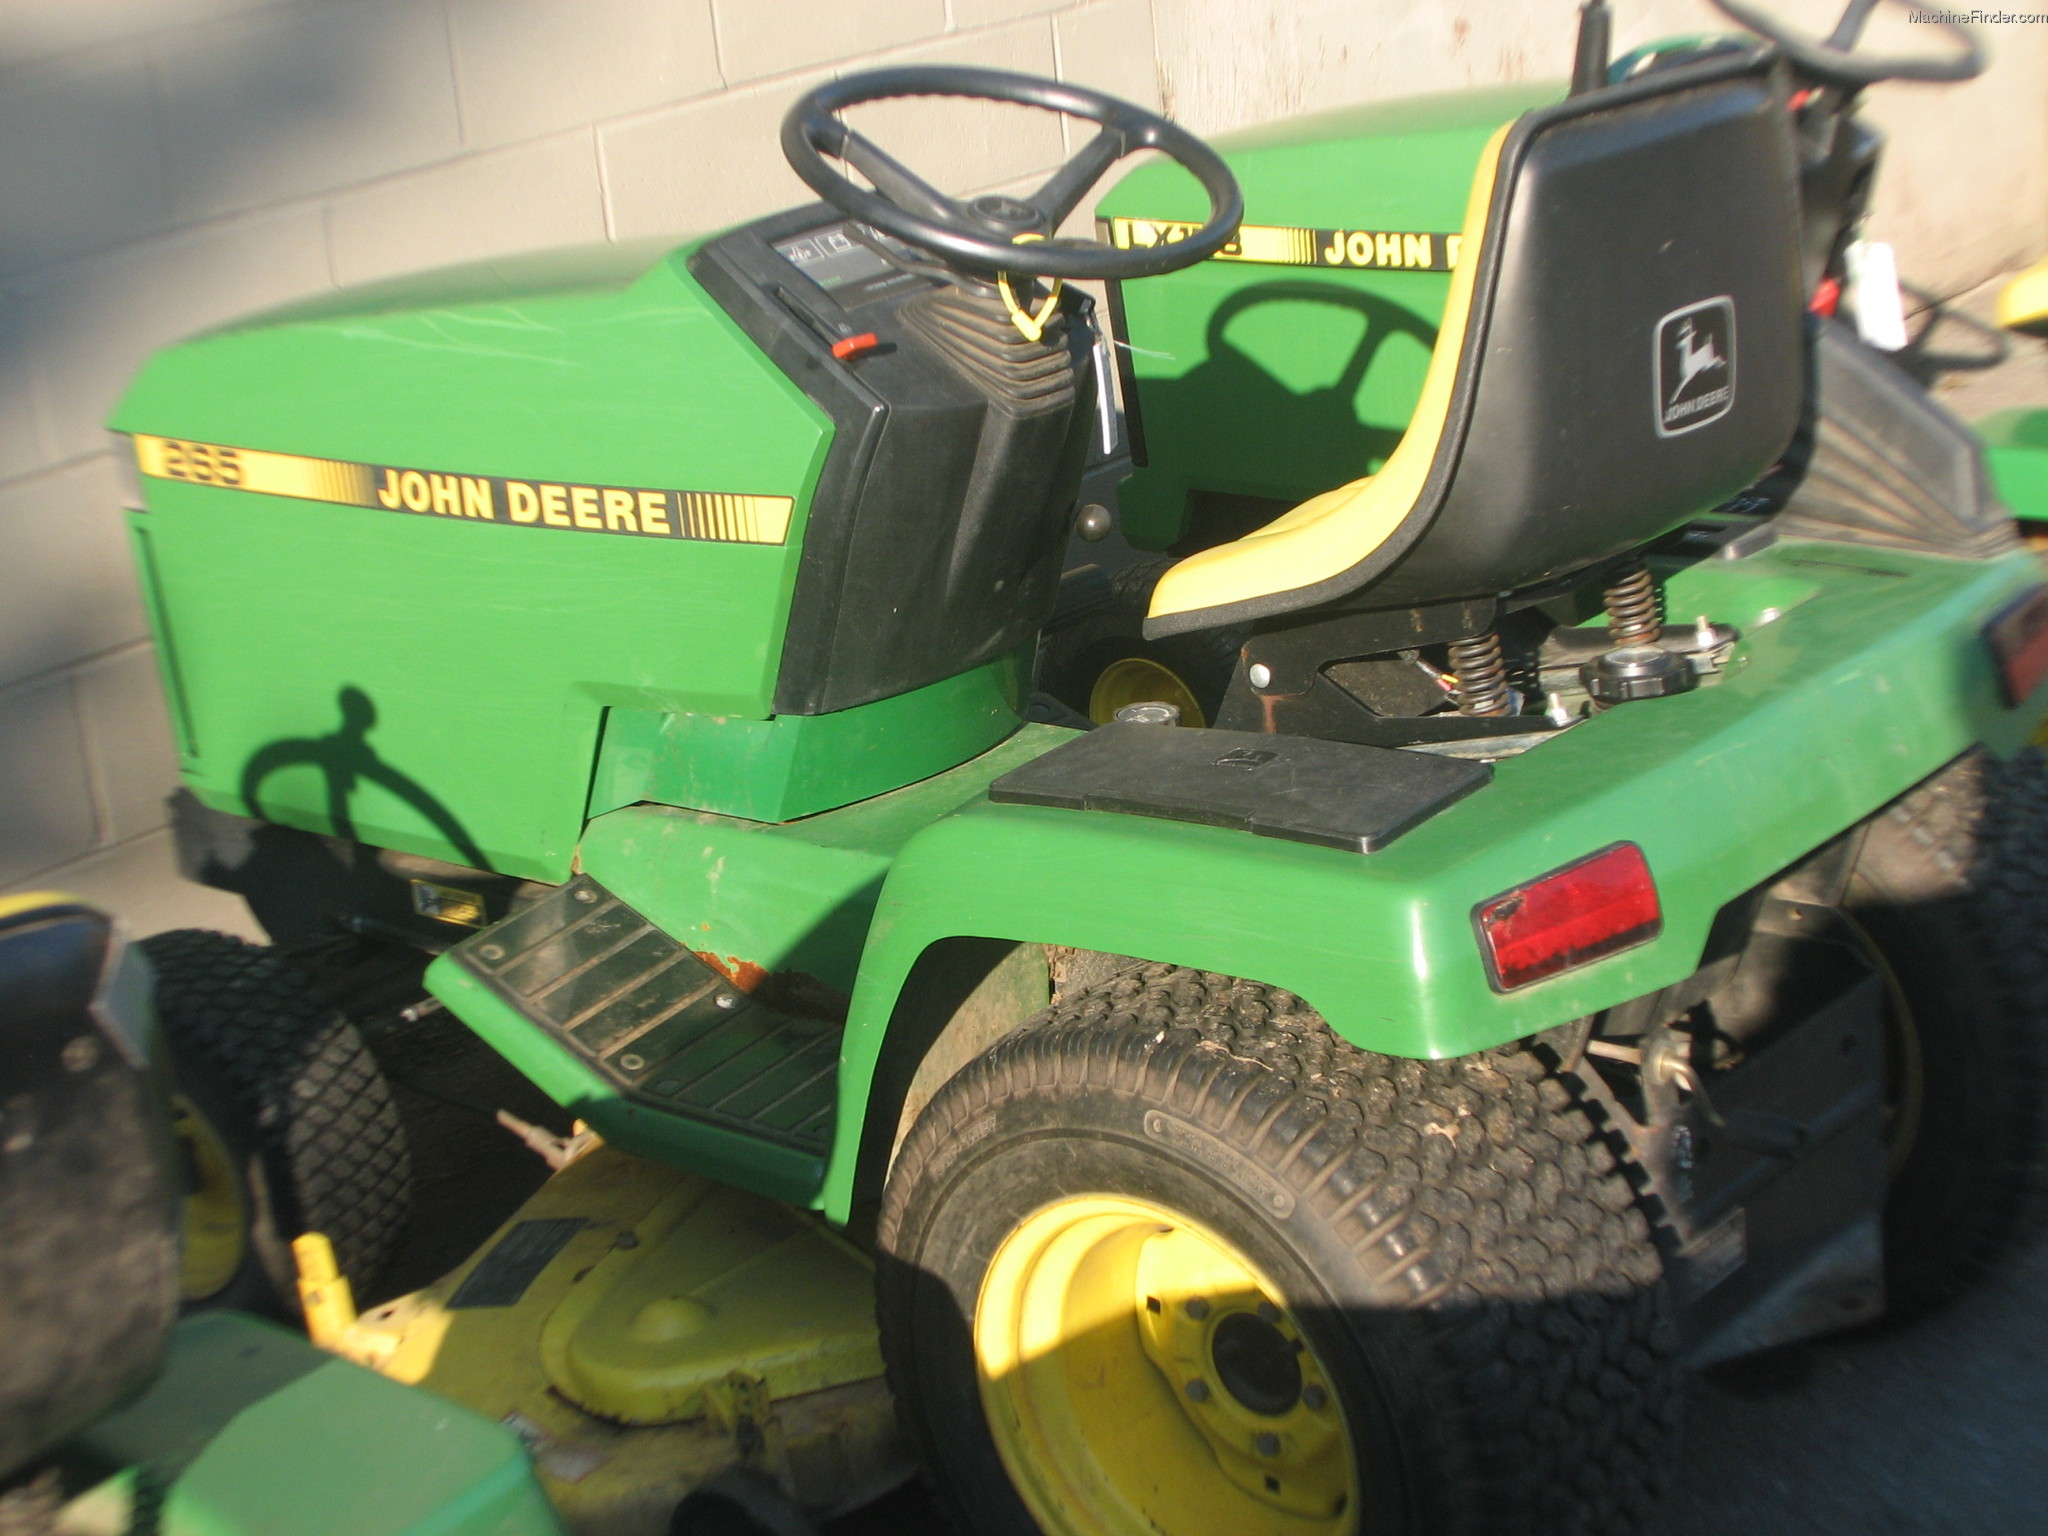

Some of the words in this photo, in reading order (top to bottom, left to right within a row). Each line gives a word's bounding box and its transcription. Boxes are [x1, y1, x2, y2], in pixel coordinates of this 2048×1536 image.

[1324, 230, 1432, 268] JOHN
[1665, 397, 1695, 422] JOHN
[1695, 385, 1730, 411] DEERE
[378, 468, 495, 520] JOHN
[505, 480, 671, 534] DEERE
